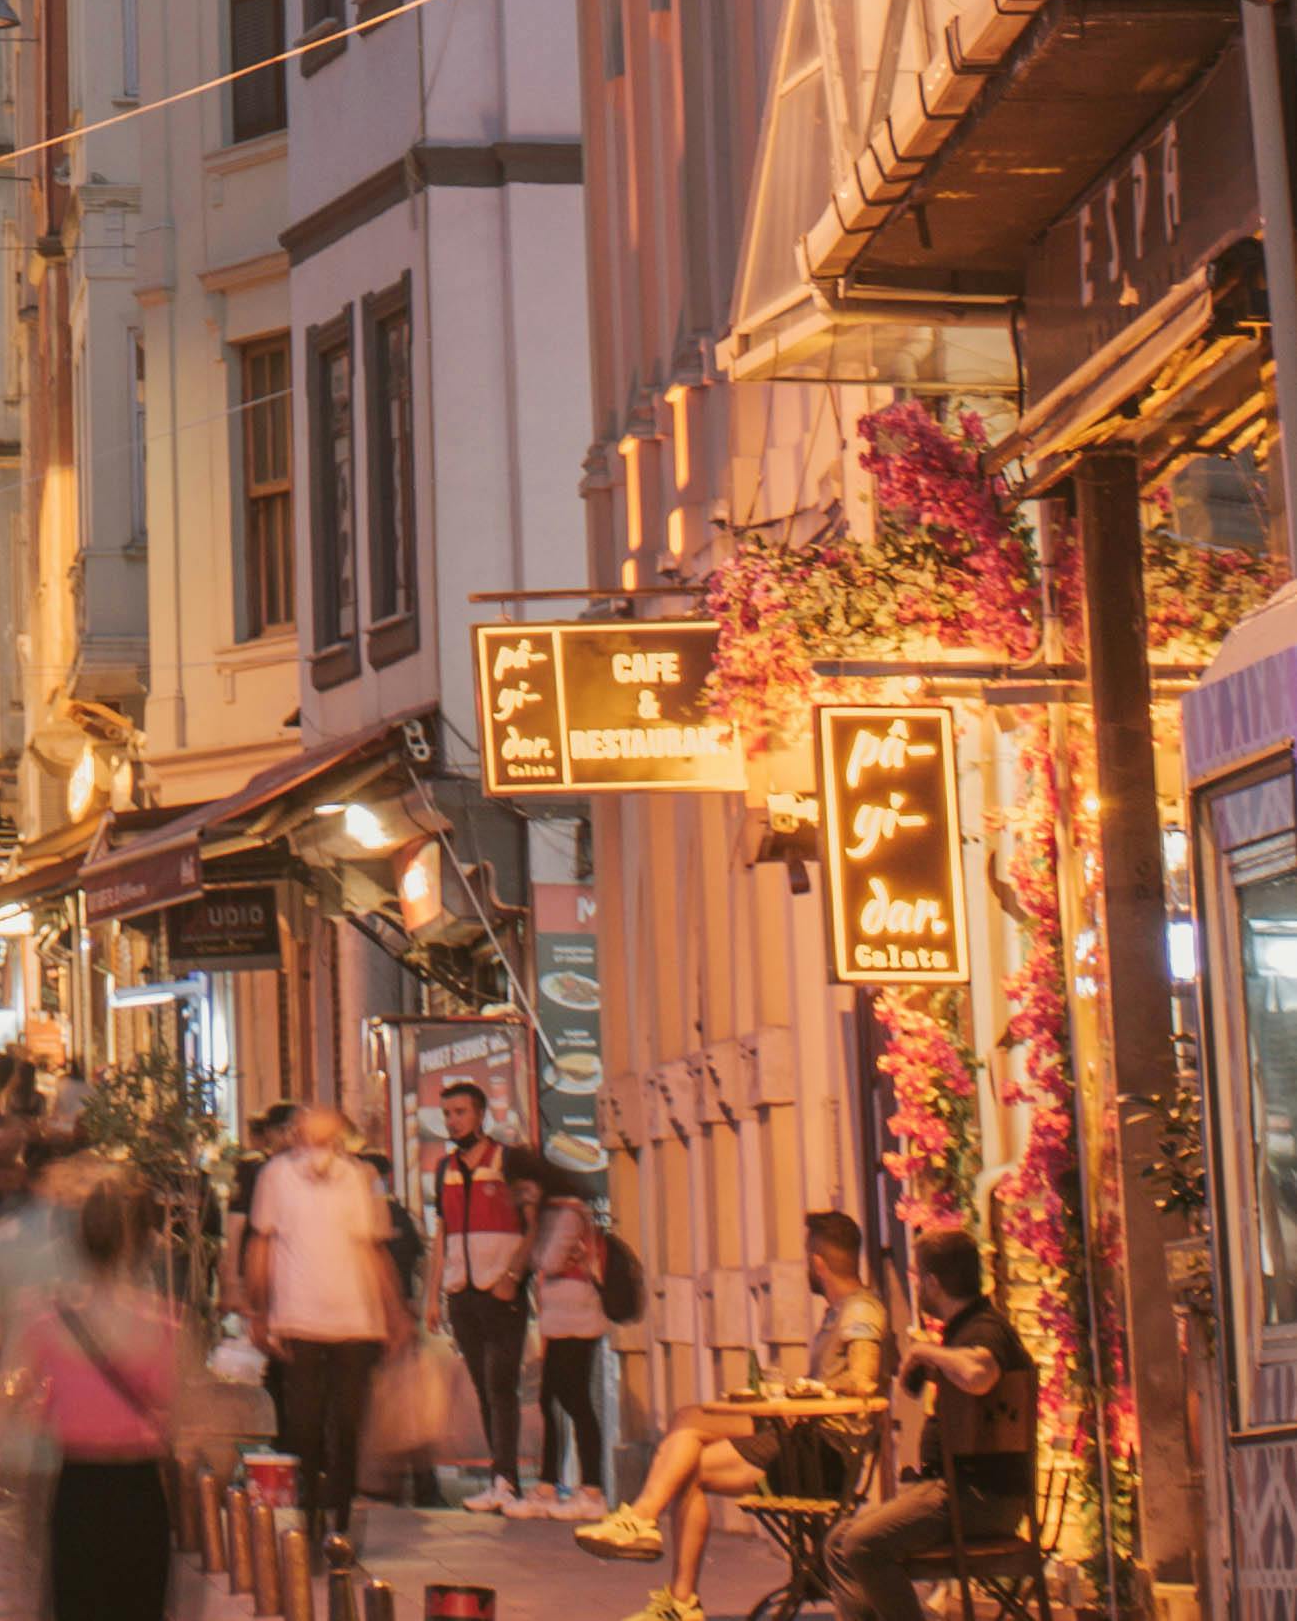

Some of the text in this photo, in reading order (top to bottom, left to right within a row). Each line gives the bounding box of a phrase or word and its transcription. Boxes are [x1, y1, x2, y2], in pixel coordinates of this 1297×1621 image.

[1079, 119, 1180, 306] ESPA
[612, 652, 680, 683] CAFE
[637, 689, 661, 719] &
[854, 944, 949, 969] Galata
